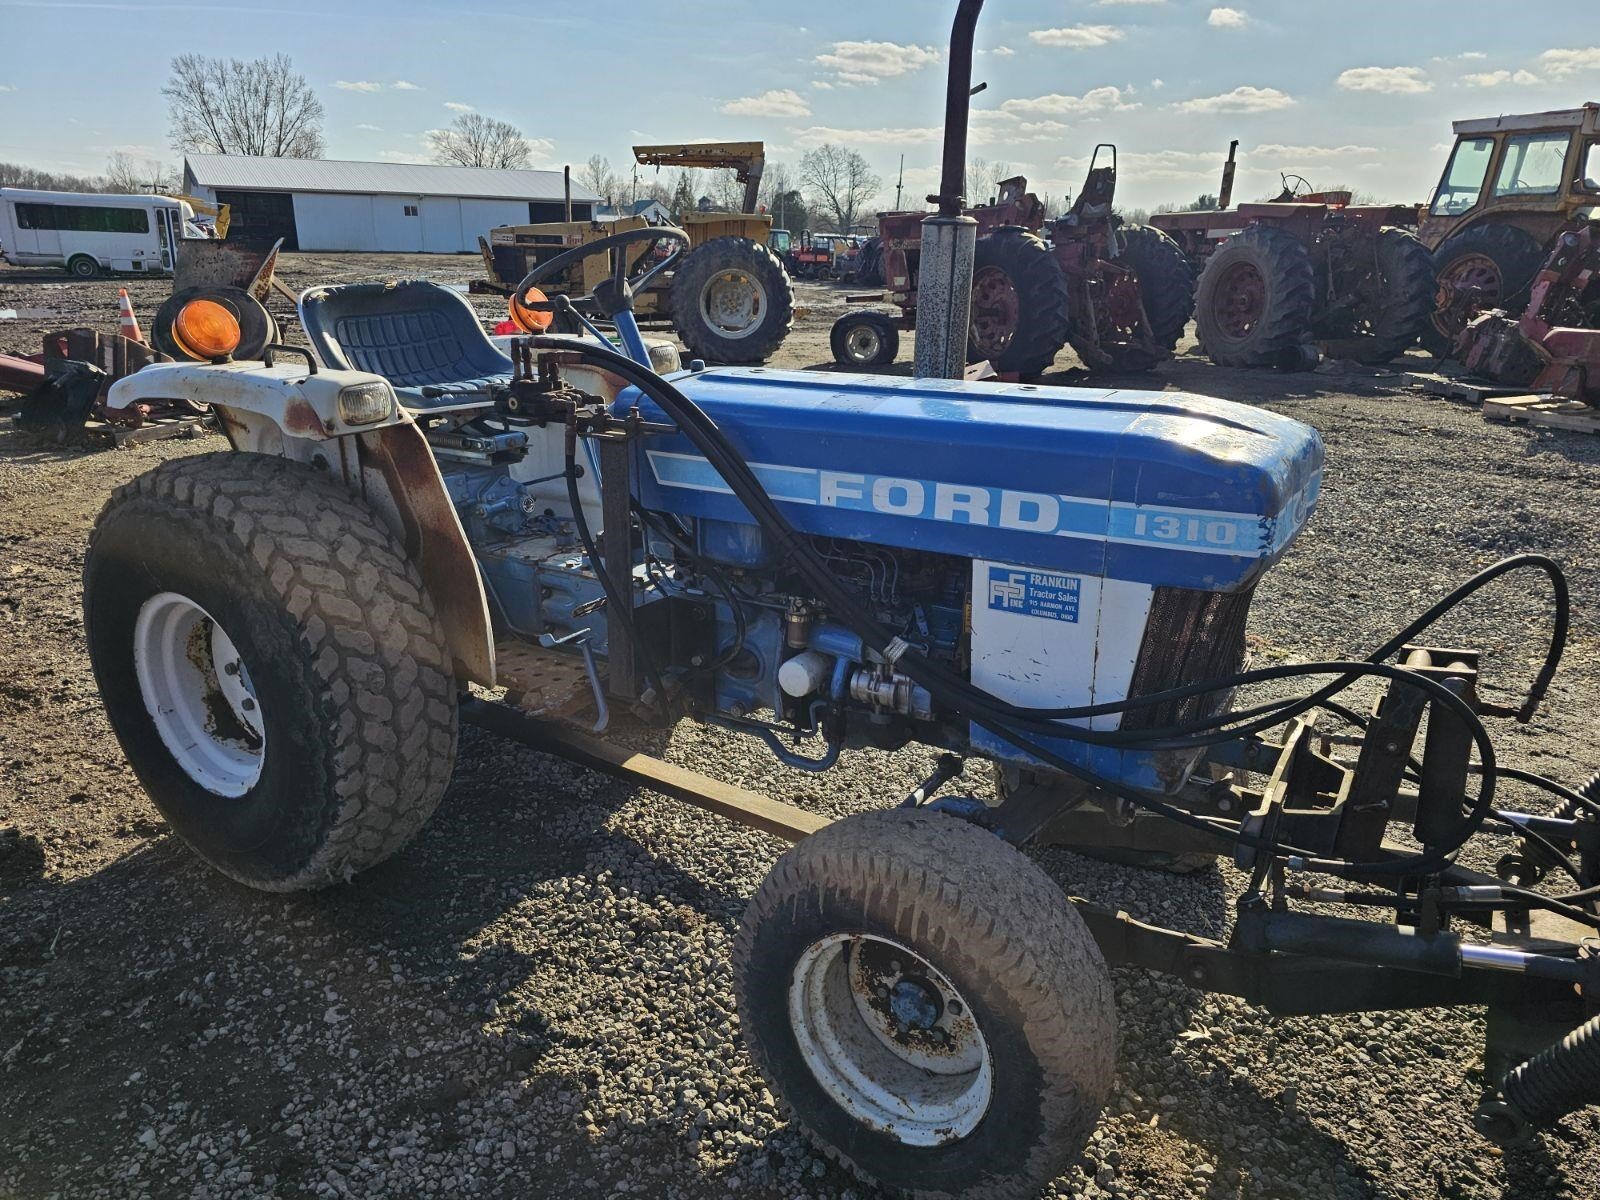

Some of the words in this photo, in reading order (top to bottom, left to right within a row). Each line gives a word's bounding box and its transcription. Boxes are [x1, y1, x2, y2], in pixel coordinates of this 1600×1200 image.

[820, 471, 1060, 533] FORD
[1134, 513, 1237, 545] 1310
[1030, 573, 1078, 591] FRANKLIN
[1029, 587, 1056, 600] Tractor
[1057, 591, 1078, 603] Sales
